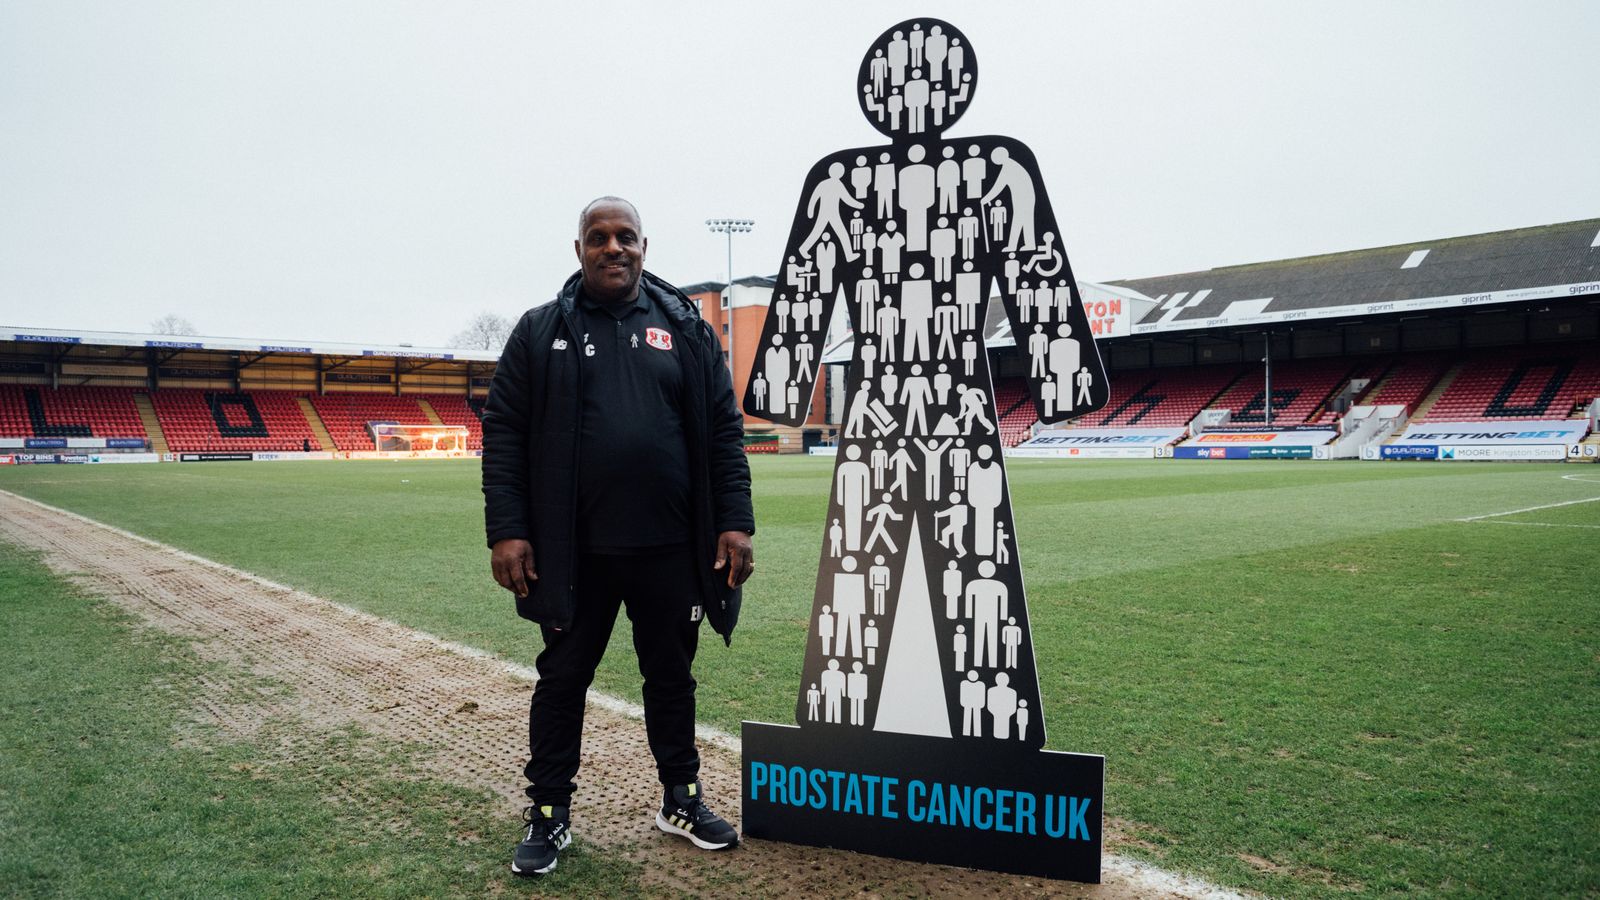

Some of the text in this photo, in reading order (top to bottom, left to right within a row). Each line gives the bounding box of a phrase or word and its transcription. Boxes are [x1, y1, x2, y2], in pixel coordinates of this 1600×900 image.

[1569, 284, 1600, 295] giprin
[1461, 294, 1492, 304] giprint
[1084, 297, 1121, 318] TON
[1366, 304, 1394, 313] giprint
[1282, 311, 1307, 320] giprint
[1091, 317, 1115, 335] NT
[1206, 318, 1229, 326] giprint
[1137, 324, 1158, 332] giprint
[1157, 447, 1163, 456] 3
[1197, 448, 1224, 457] sky bet
[1494, 449, 1532, 458] Kingston
[1571, 445, 1580, 456] 4
[751, 761, 1091, 841] PROSTATE CANCER UK
